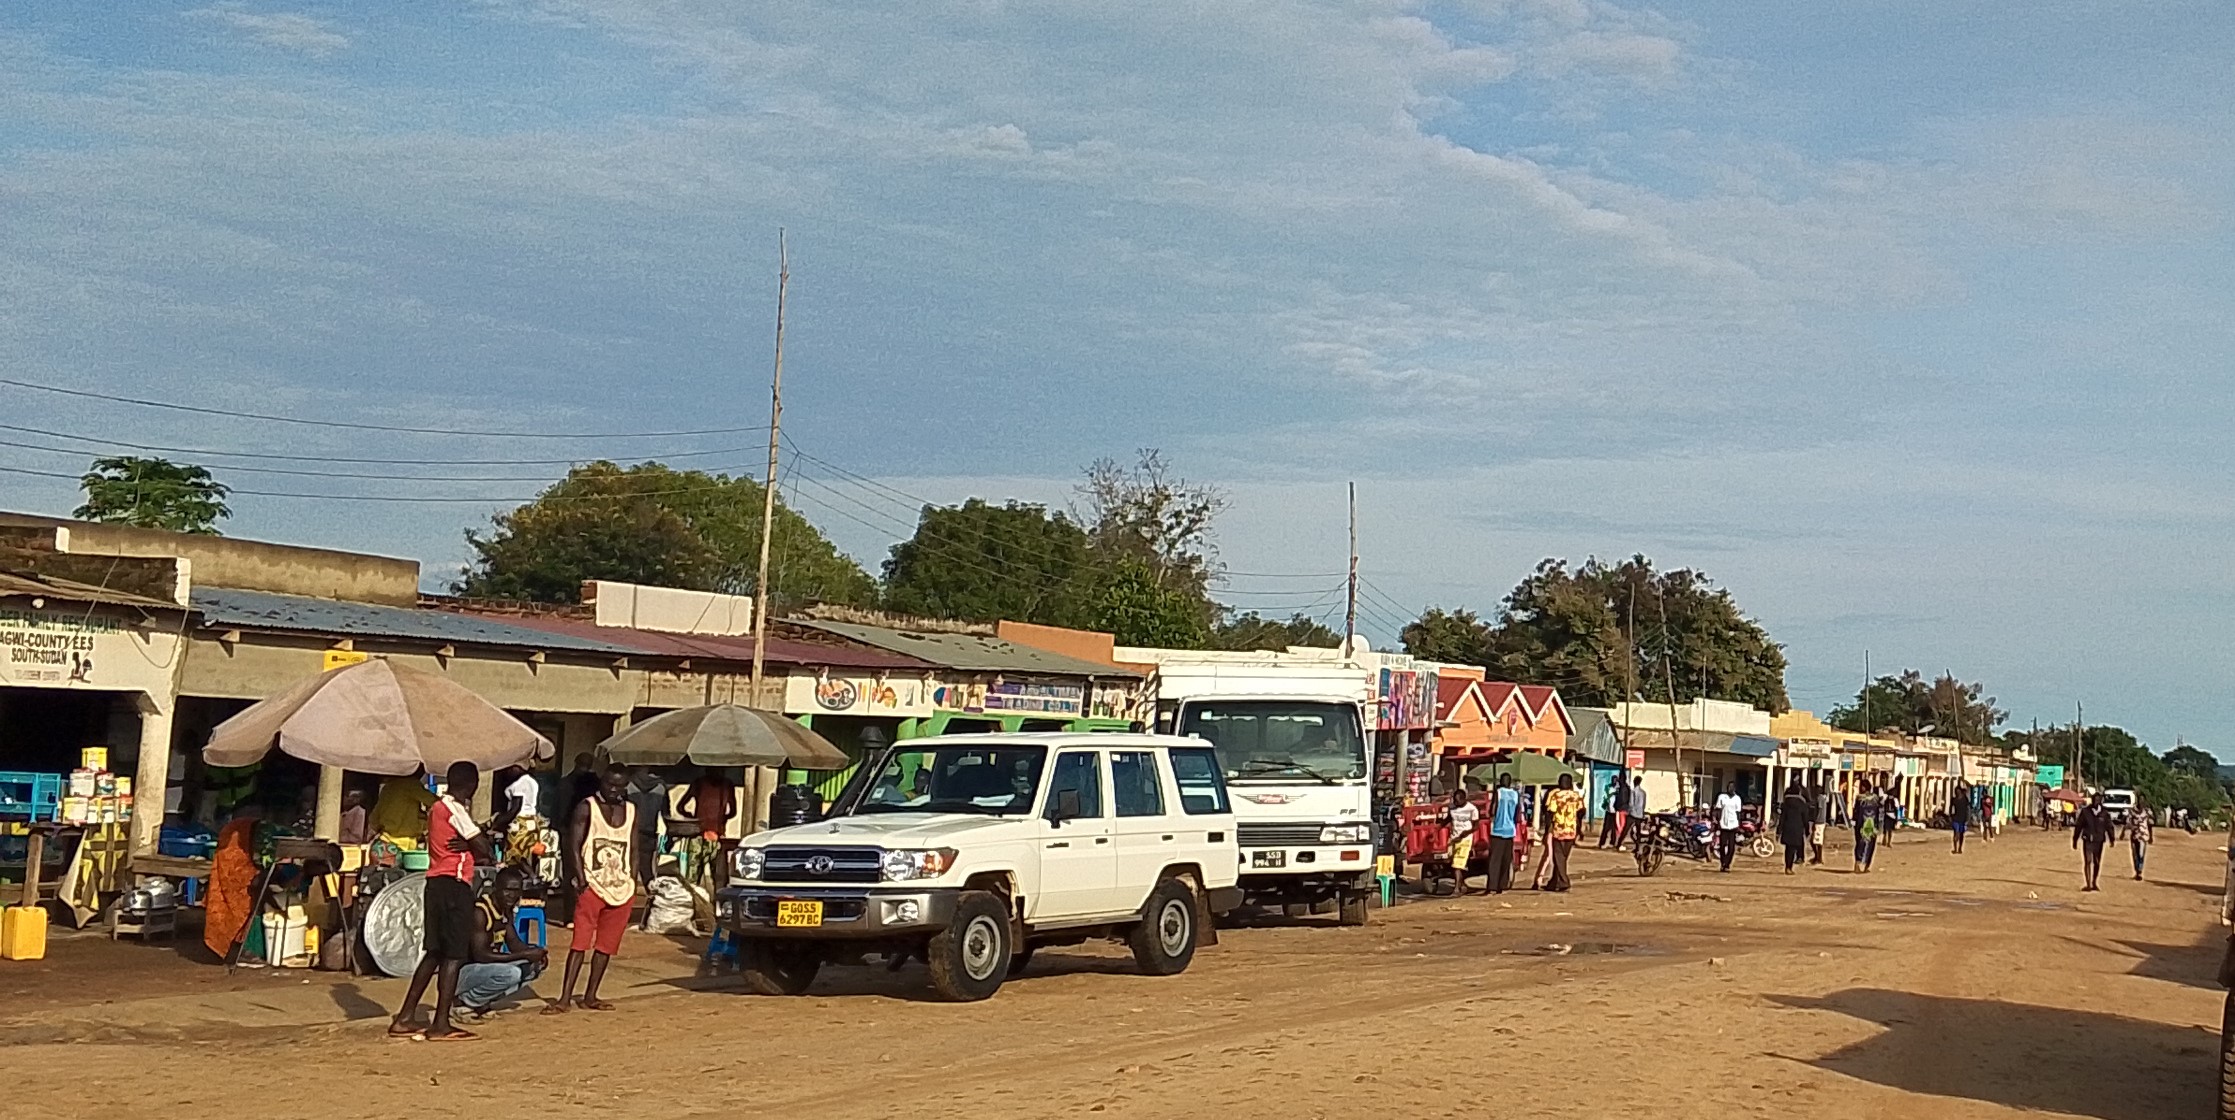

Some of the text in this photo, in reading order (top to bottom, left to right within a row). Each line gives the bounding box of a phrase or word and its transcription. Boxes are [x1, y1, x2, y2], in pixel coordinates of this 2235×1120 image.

[790, 903, 816, 913] GOSS
[780, 914, 819, 924] 6297 BC
